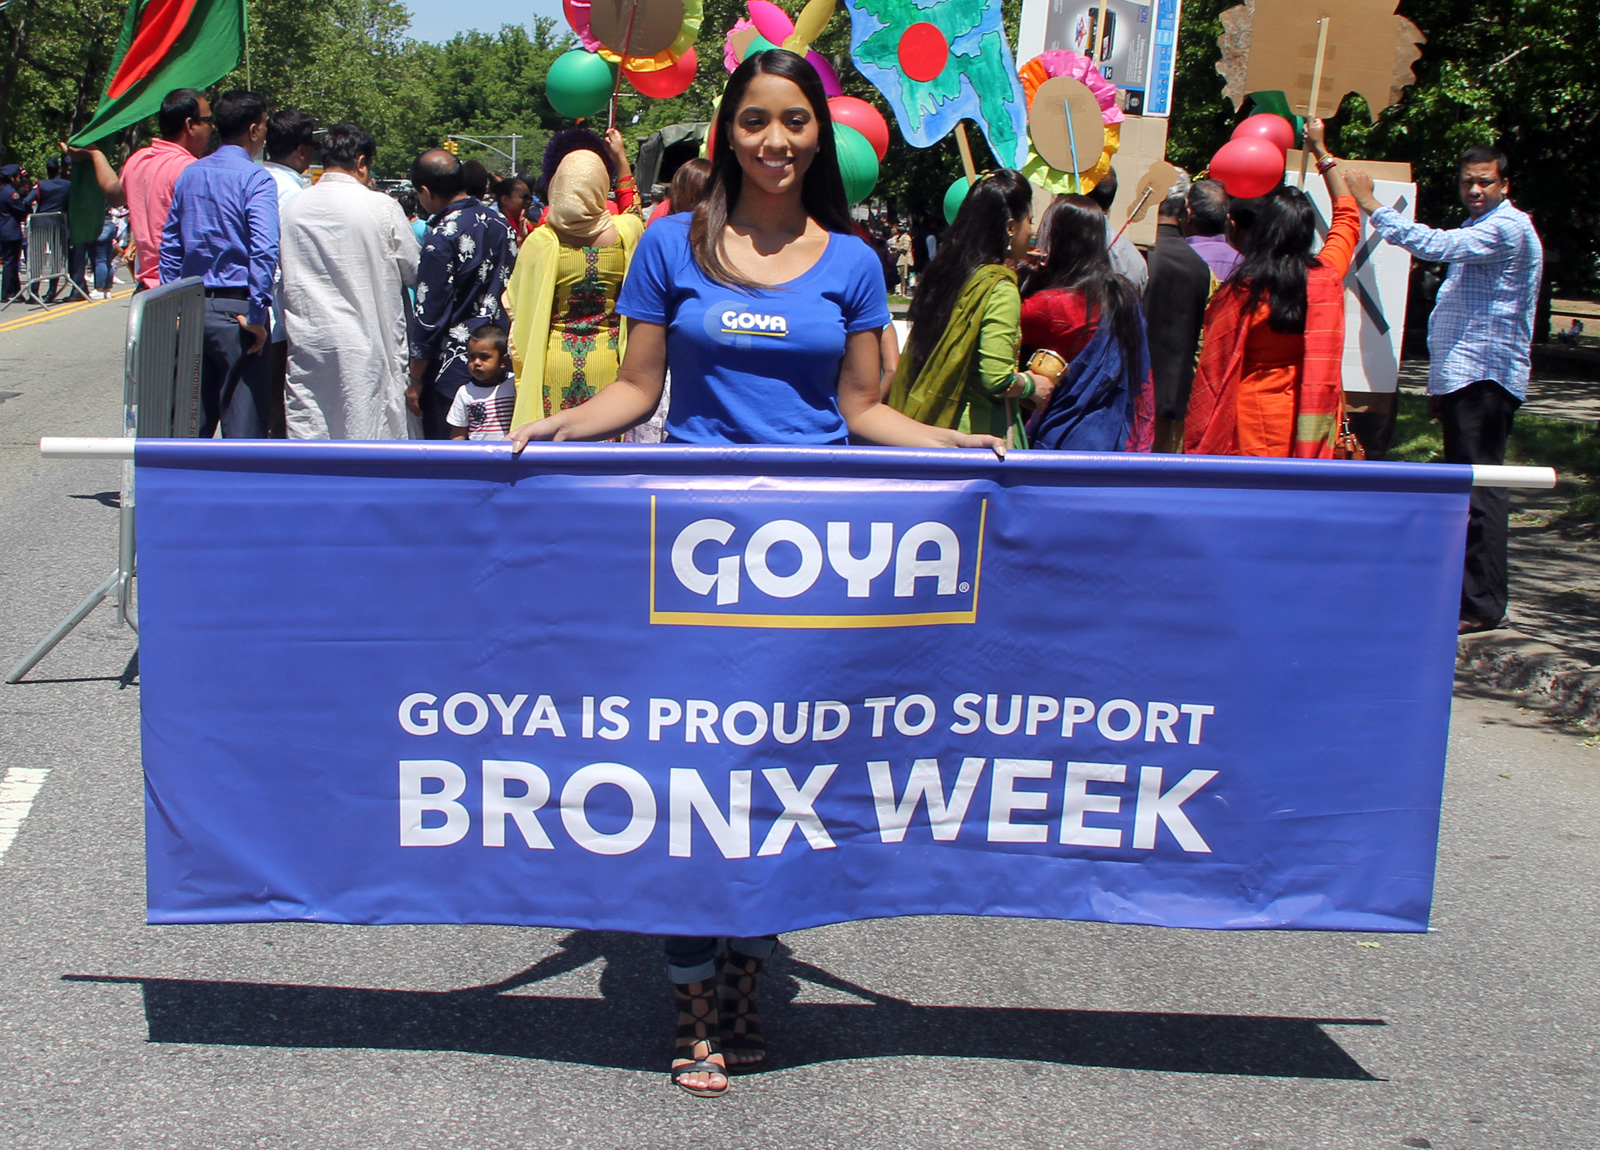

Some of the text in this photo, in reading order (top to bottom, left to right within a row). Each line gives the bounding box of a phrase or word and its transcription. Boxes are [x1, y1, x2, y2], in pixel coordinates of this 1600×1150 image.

[721, 310, 787, 331] GOYA
[671, 518, 961, 606] GOYA
[398, 692, 1215, 746] GOYA IS PROUD TO SUPPORT
[399, 757, 1220, 859] BRONX WEEK
